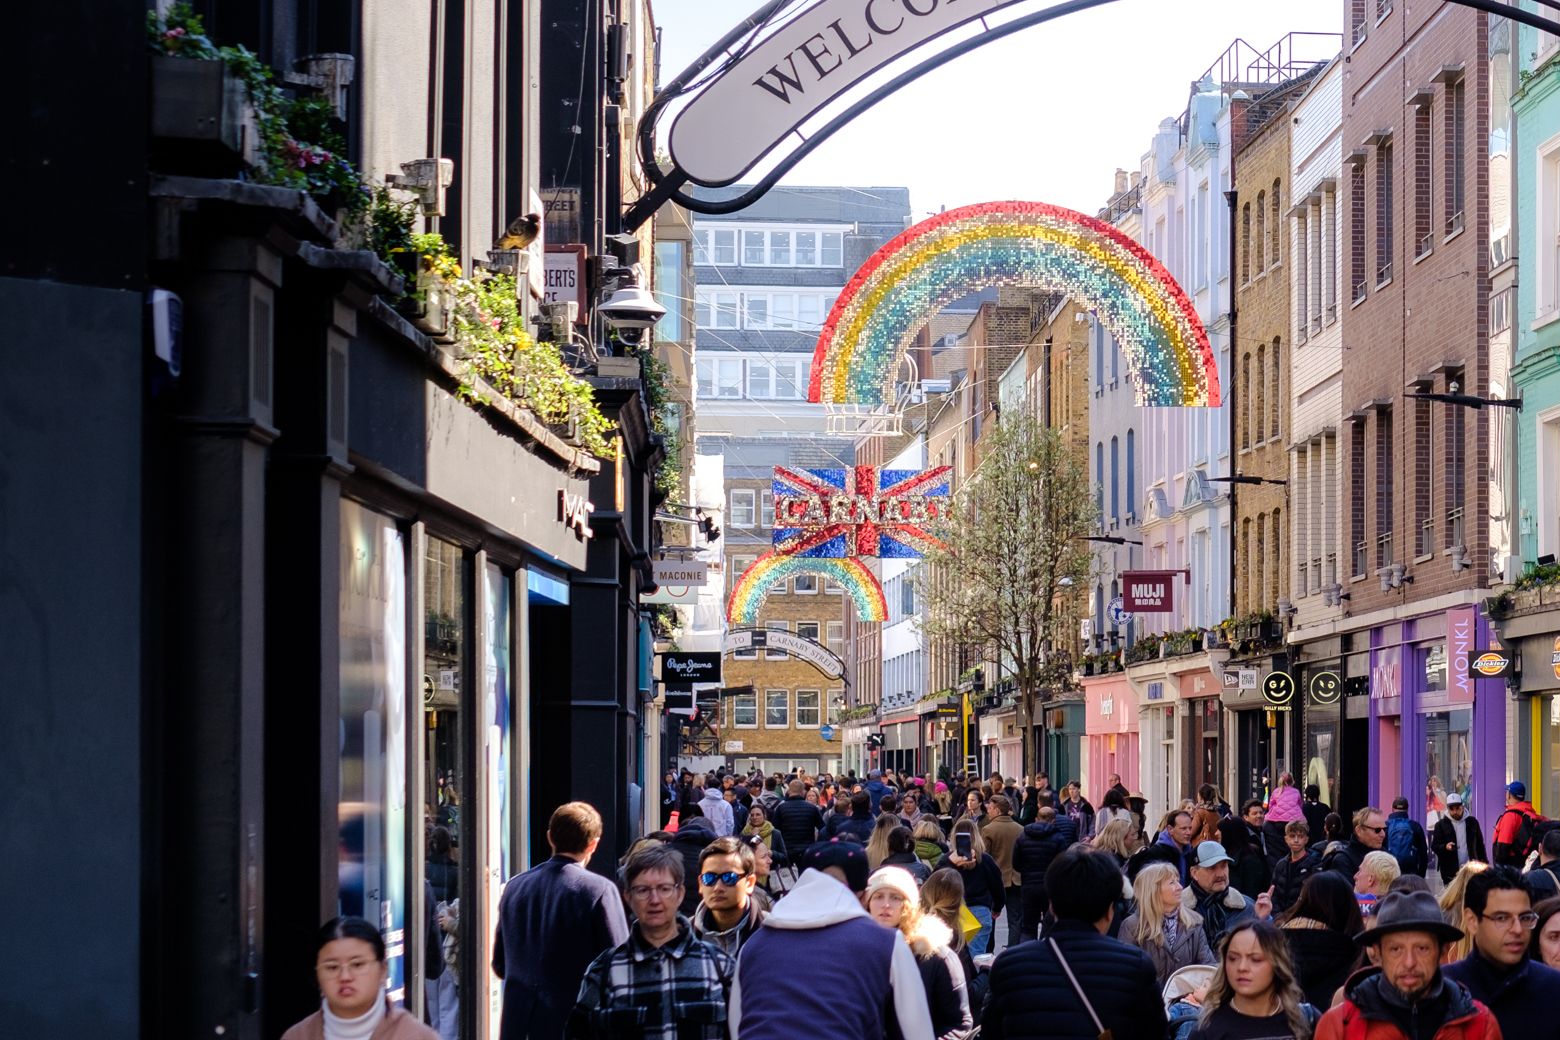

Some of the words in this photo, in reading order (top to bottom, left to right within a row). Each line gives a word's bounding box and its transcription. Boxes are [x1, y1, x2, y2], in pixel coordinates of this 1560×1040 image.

[557, 488, 595, 539] MAC
[659, 571, 702, 581] MACONIE
[1131, 583, 1165, 598] MUJI
[733, 636, 745, 645] TO
[770, 635, 810, 652] CARNABY
[810, 649, 838, 671] STREET
[667, 658, 687, 672] Pepe
[686, 659, 712, 673] Jeans
[1477, 660, 1505, 668] Dickies
